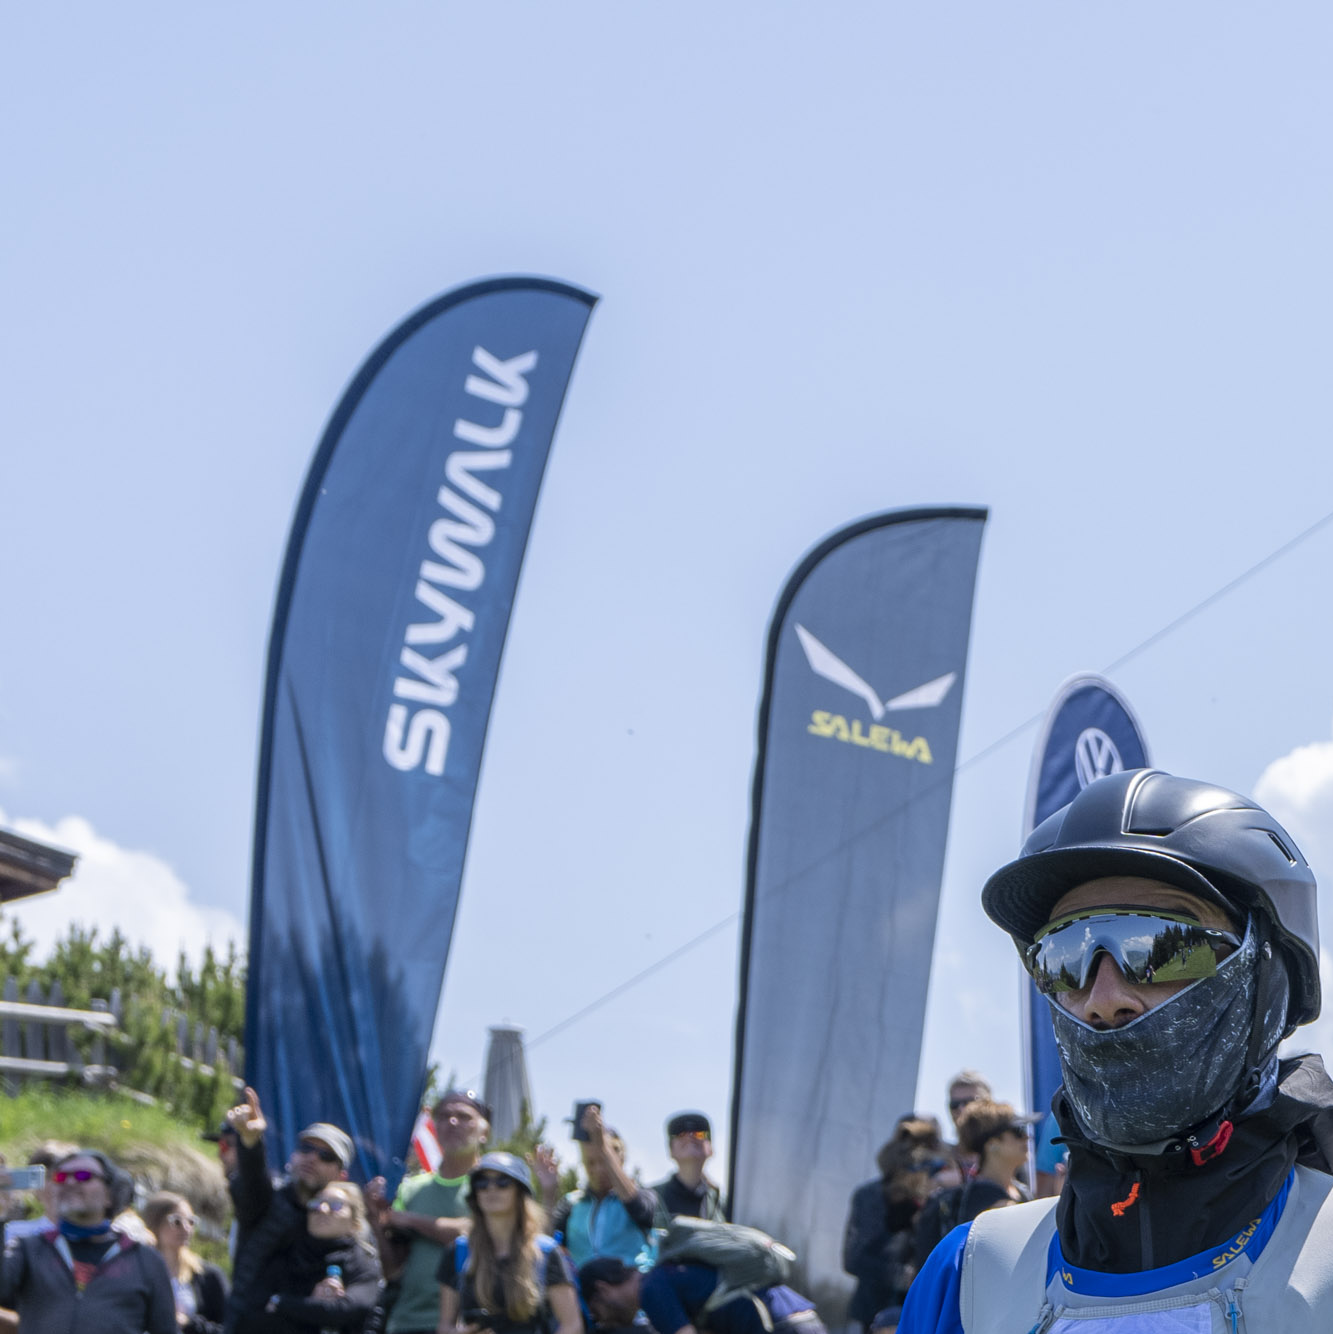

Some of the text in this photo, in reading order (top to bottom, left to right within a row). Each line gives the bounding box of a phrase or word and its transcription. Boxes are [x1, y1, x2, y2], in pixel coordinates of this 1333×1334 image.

[381, 344, 539, 776] SKYWALK
[807, 709, 933, 765] SALEWA
[1212, 1217, 1263, 1270] SALEWA
